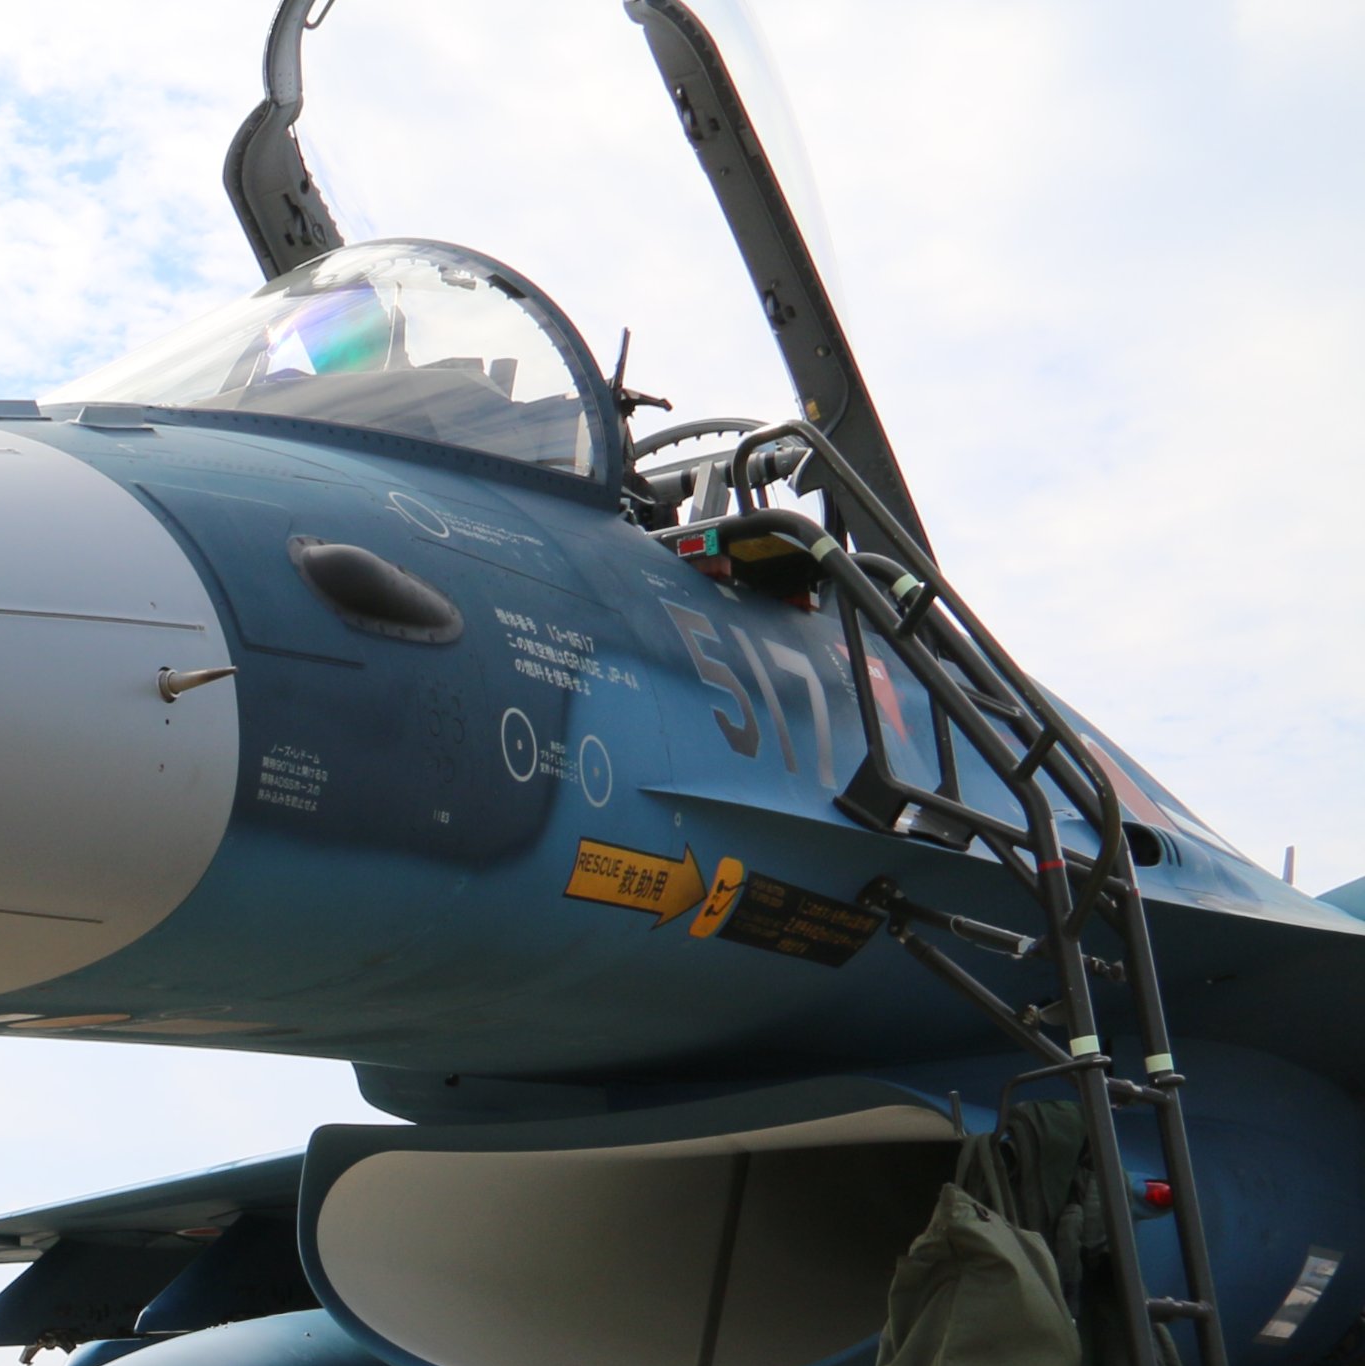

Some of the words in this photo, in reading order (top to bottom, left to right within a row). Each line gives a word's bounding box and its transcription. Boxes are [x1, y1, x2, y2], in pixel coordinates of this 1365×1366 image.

[658, 597, 837, 788] 517
[577, 852, 623, 878] RESCUE
[617, 865, 668, 901] 救助用
